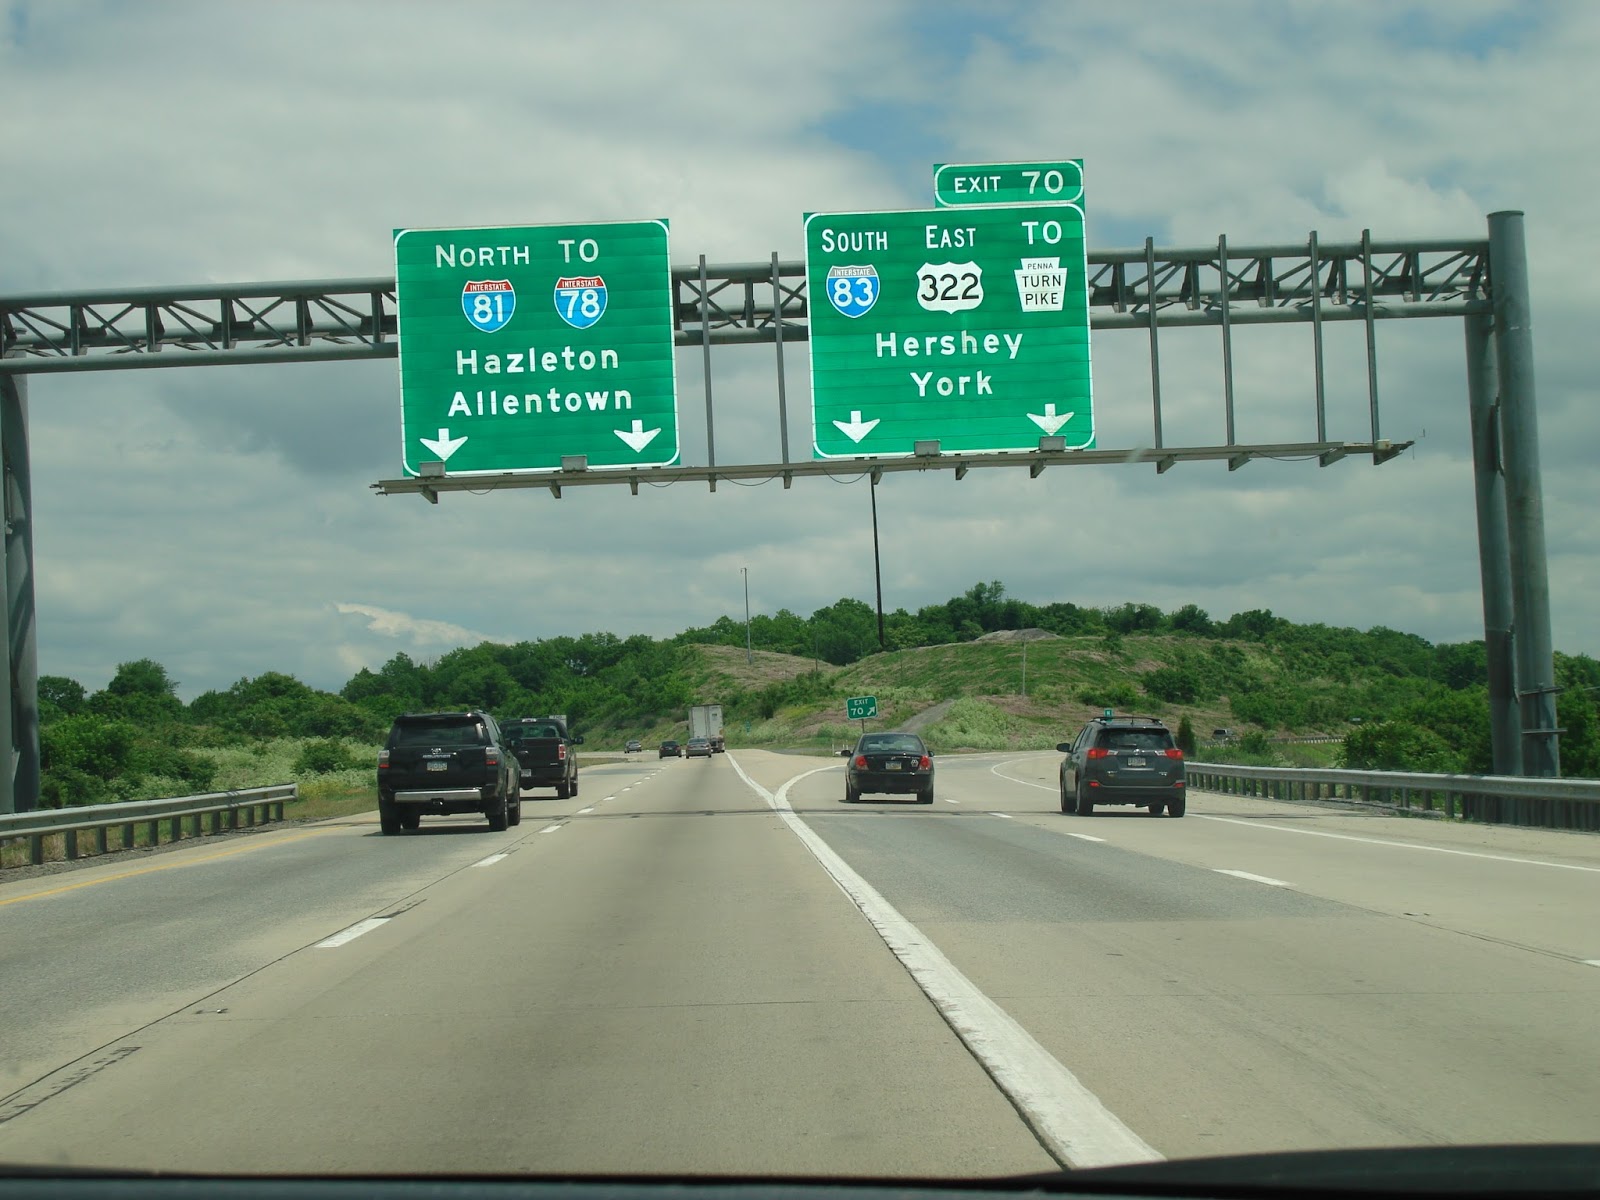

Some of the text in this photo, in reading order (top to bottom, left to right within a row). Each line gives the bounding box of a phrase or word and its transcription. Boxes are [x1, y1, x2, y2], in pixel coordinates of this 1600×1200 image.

[954, 170, 1065, 195] EXIT 70
[821, 228, 888, 253] SOUTH
[925, 224, 976, 249] EAST
[1021, 220, 1063, 245] TO
[435, 238, 599, 268] NORTH TO
[834, 268, 871, 277] INTERSTATE
[1027, 262, 1054, 271] PENNA
[470, 283, 507, 292] INTERSTATE
[562, 279, 599, 288] INTERSTATE
[833, 277, 874, 307] 83
[920, 272, 980, 302] 322
[1021, 274, 1062, 288] TURN
[473, 294, 504, 324] 81
[560, 289, 600, 319] 78
[1025, 292, 1059, 306] PIKE
[875, 330, 1023, 359] Hershey
[456, 346, 619, 375] Hazleton
[910, 370, 993, 397] York
[448, 387, 632, 417] Allentown
[850, 707, 864, 716] 70
[853, 698, 868, 706] EXIT
